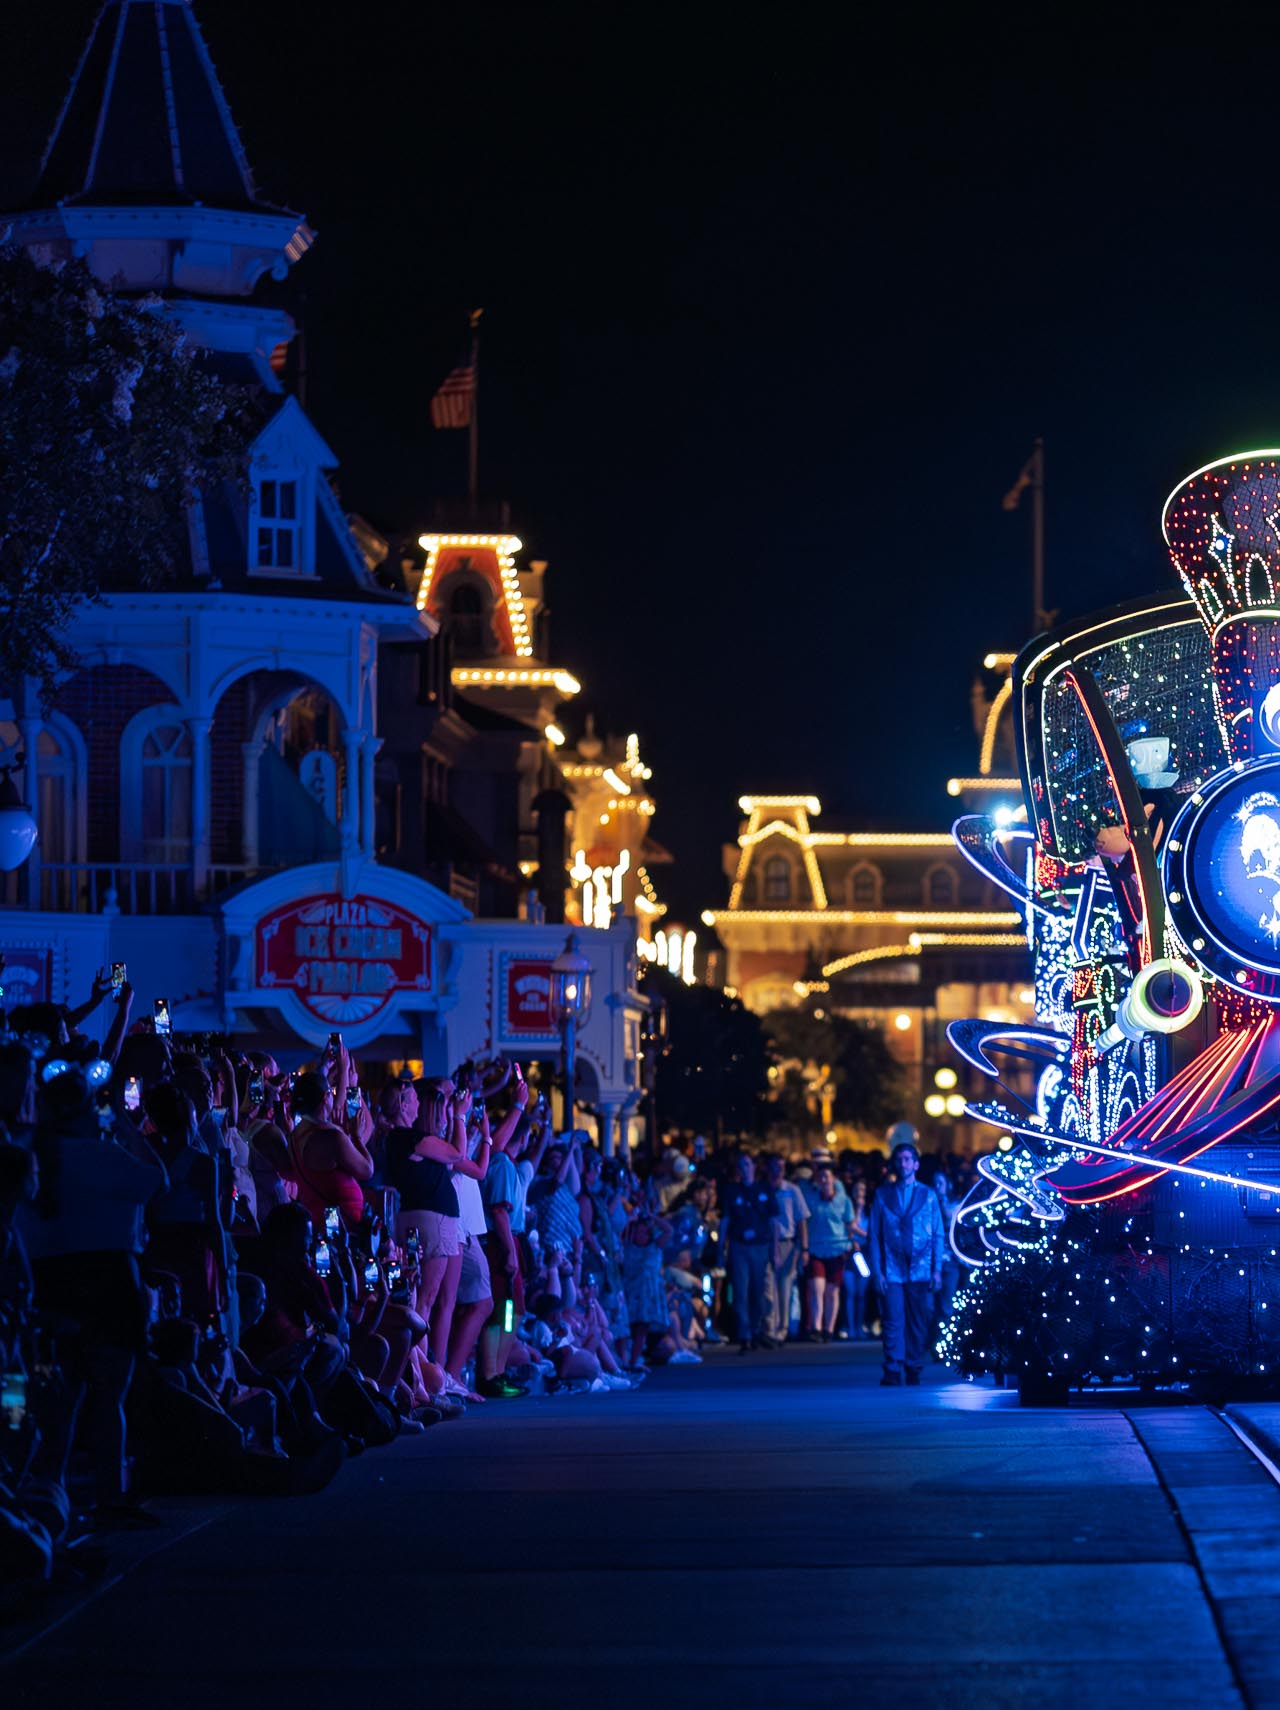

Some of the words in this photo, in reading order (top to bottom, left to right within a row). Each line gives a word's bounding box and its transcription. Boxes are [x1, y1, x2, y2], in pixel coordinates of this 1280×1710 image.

[325, 901, 367, 926] PLAZA
[295, 926, 331, 958] ICE
[333, 926, 402, 960] CREAM
[310, 961, 387, 994] PARLOR
